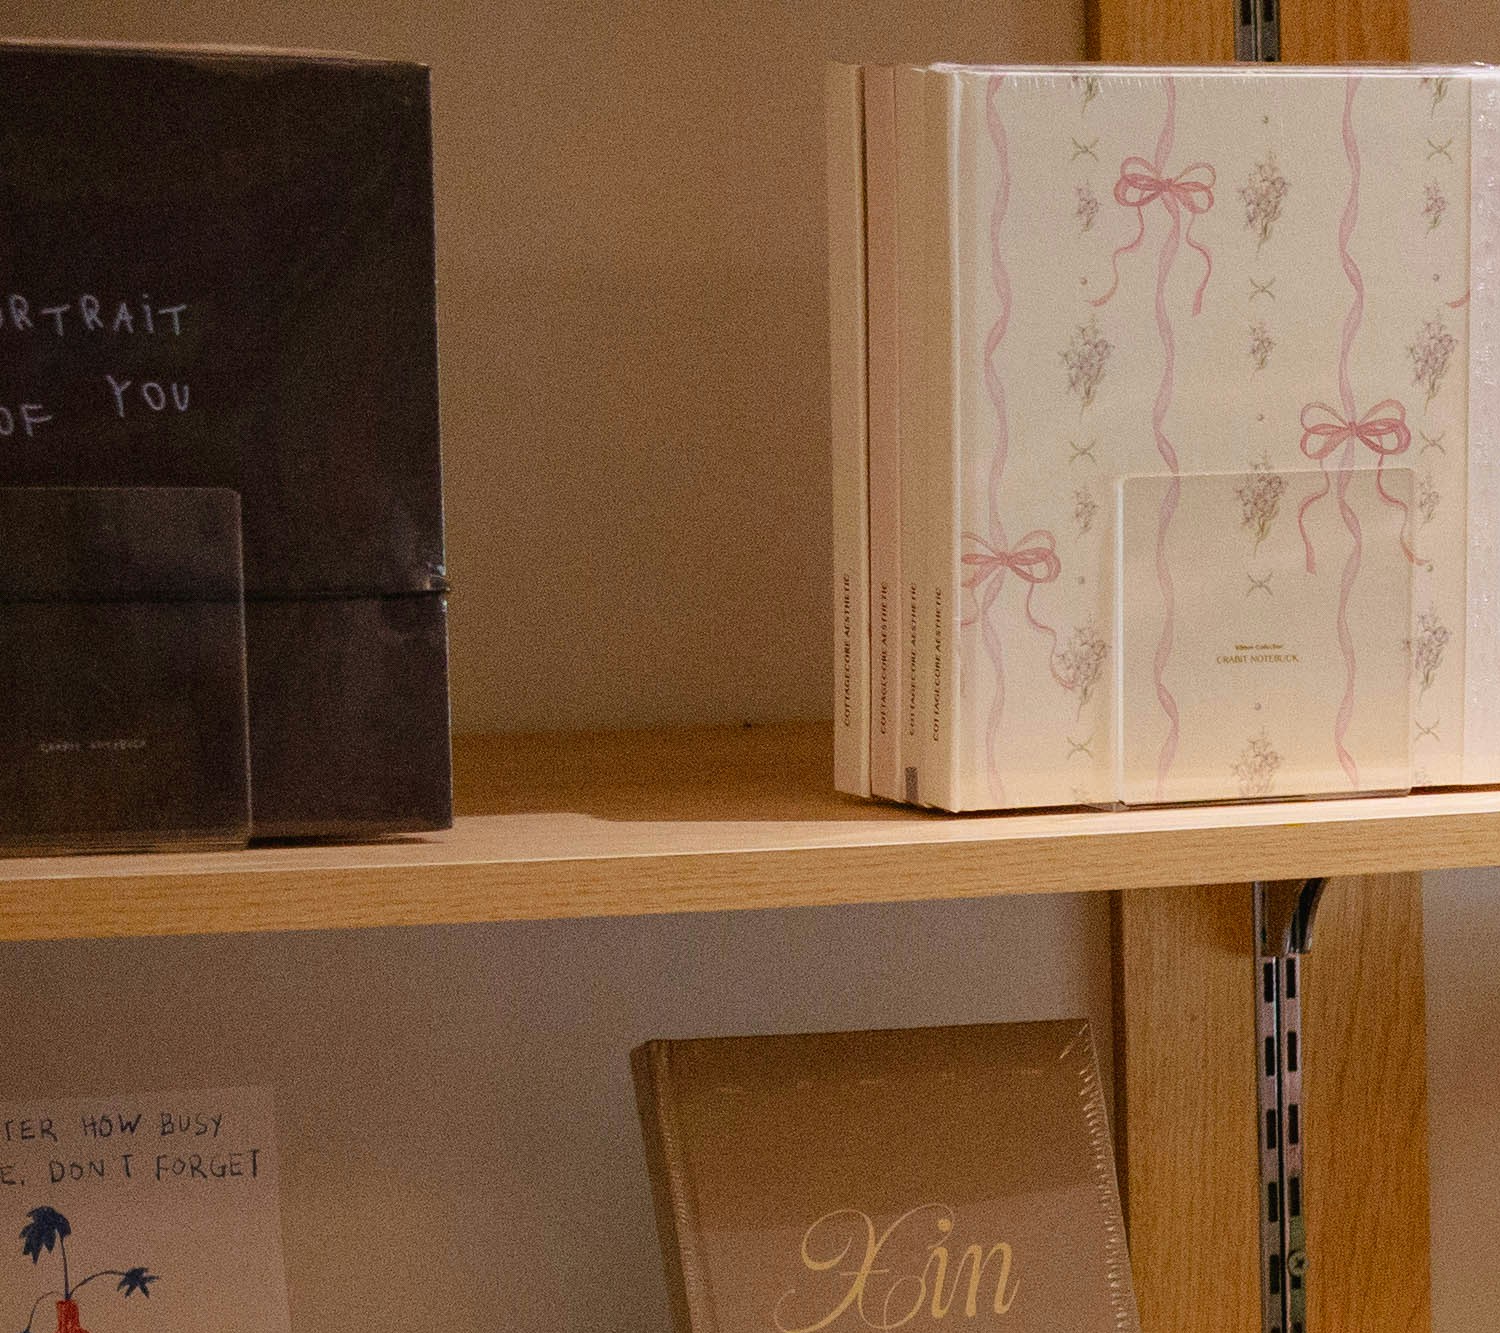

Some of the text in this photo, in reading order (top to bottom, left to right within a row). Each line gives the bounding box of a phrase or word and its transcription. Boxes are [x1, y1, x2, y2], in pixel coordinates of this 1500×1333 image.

[105, 374, 190, 418] YOU
[81, 1112, 223, 1139] HOW BUSY
[154, 1148, 261, 1181] FORGET
